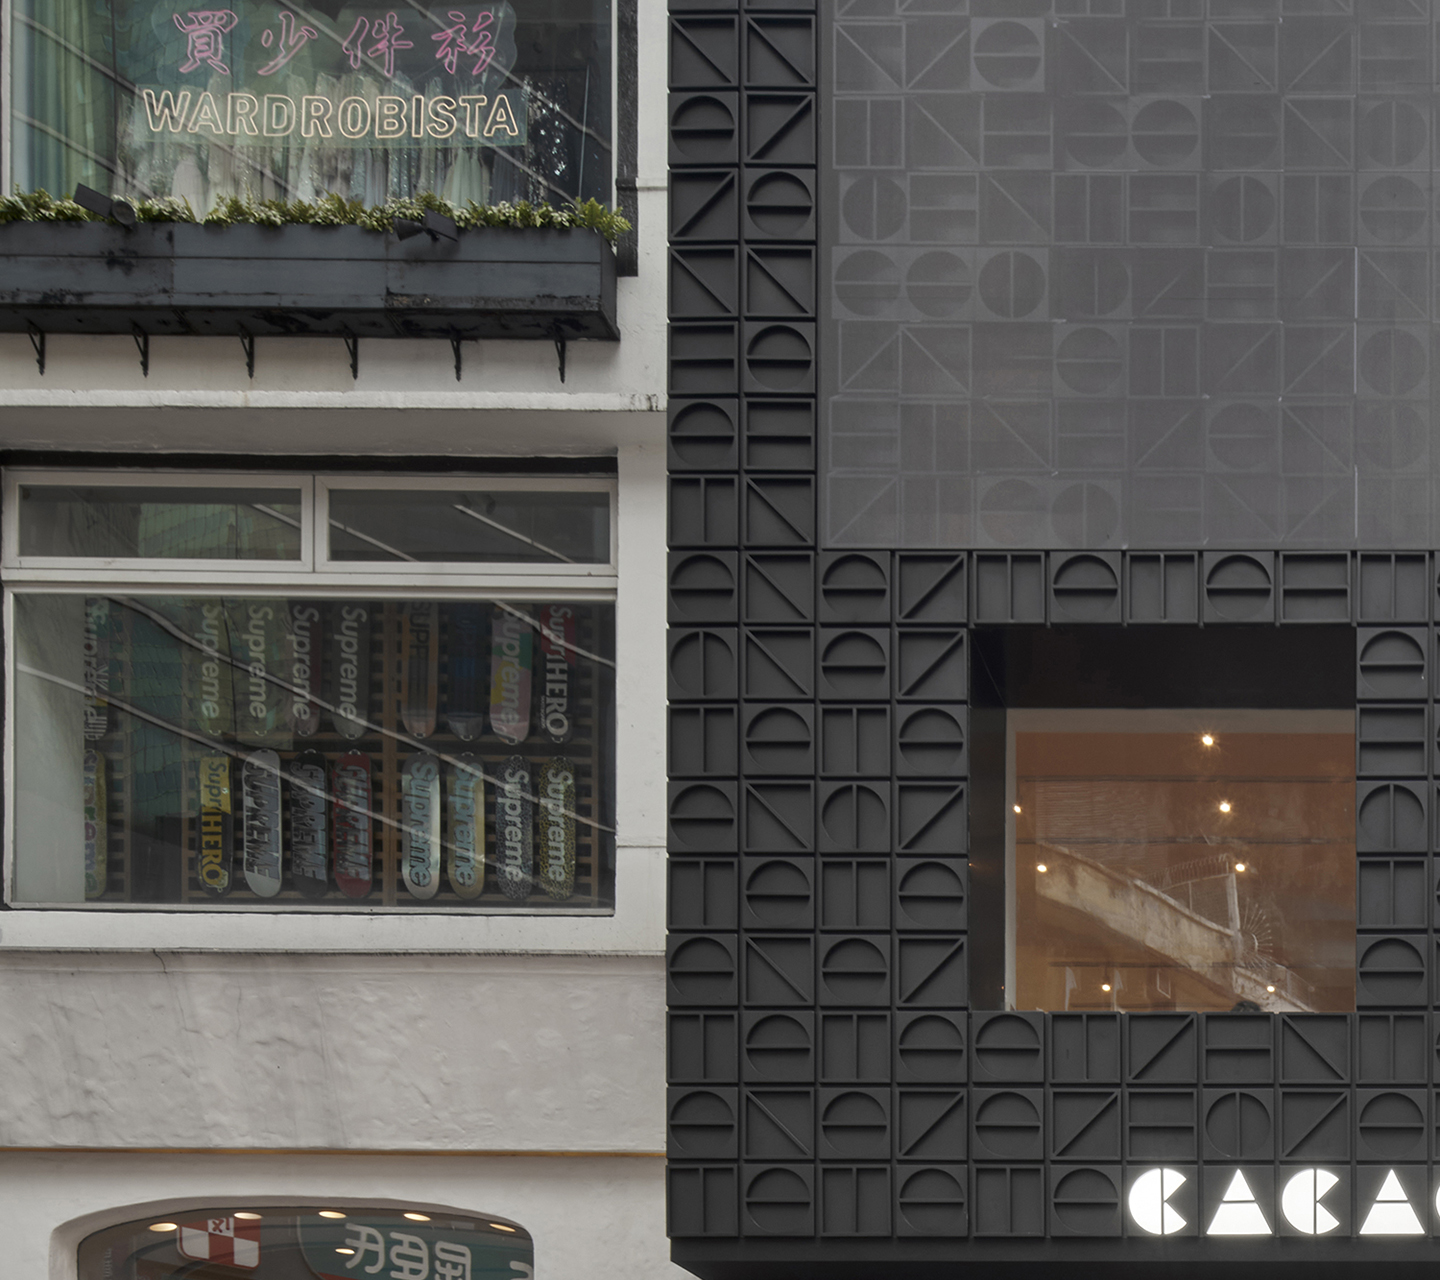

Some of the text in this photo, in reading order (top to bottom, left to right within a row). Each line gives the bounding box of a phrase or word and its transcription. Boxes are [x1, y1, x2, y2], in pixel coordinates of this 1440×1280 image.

[172, 9, 497, 77] 買少件衫
[142, 88, 519, 139] WARDROBISTA
[195, 603, 226, 719] Supreme
[242, 604, 273, 720] Supreme
[286, 604, 319, 721] Supreme
[334, 605, 367, 719] Supreme
[404, 761, 436, 887] Supreme
[449, 761, 482, 887] Supreme
[497, 769, 529, 882] Supreme
[540, 769, 573, 883] Supreme
